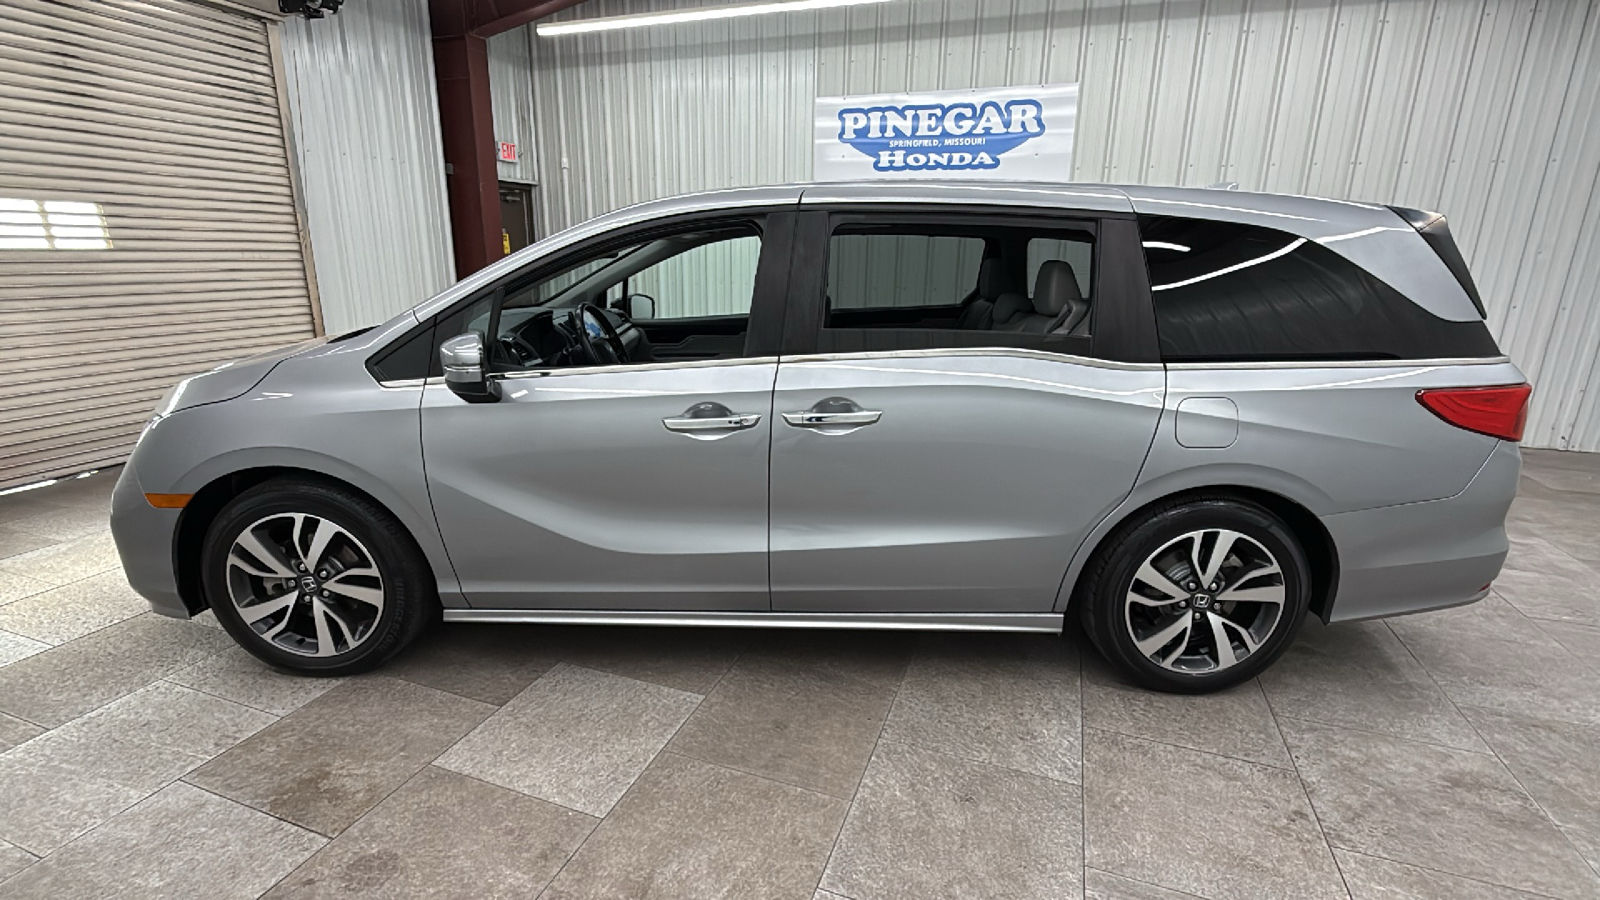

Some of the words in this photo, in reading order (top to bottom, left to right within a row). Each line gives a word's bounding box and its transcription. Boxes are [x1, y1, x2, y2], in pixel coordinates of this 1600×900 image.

[842, 104, 1041, 139] PINEGAR
[501, 142, 516, 160] EXIT
[889, 139, 942, 148] SPRINGFIELD,
[944, 137, 986, 146] MISSOURI
[877, 149, 996, 167] HONDA
